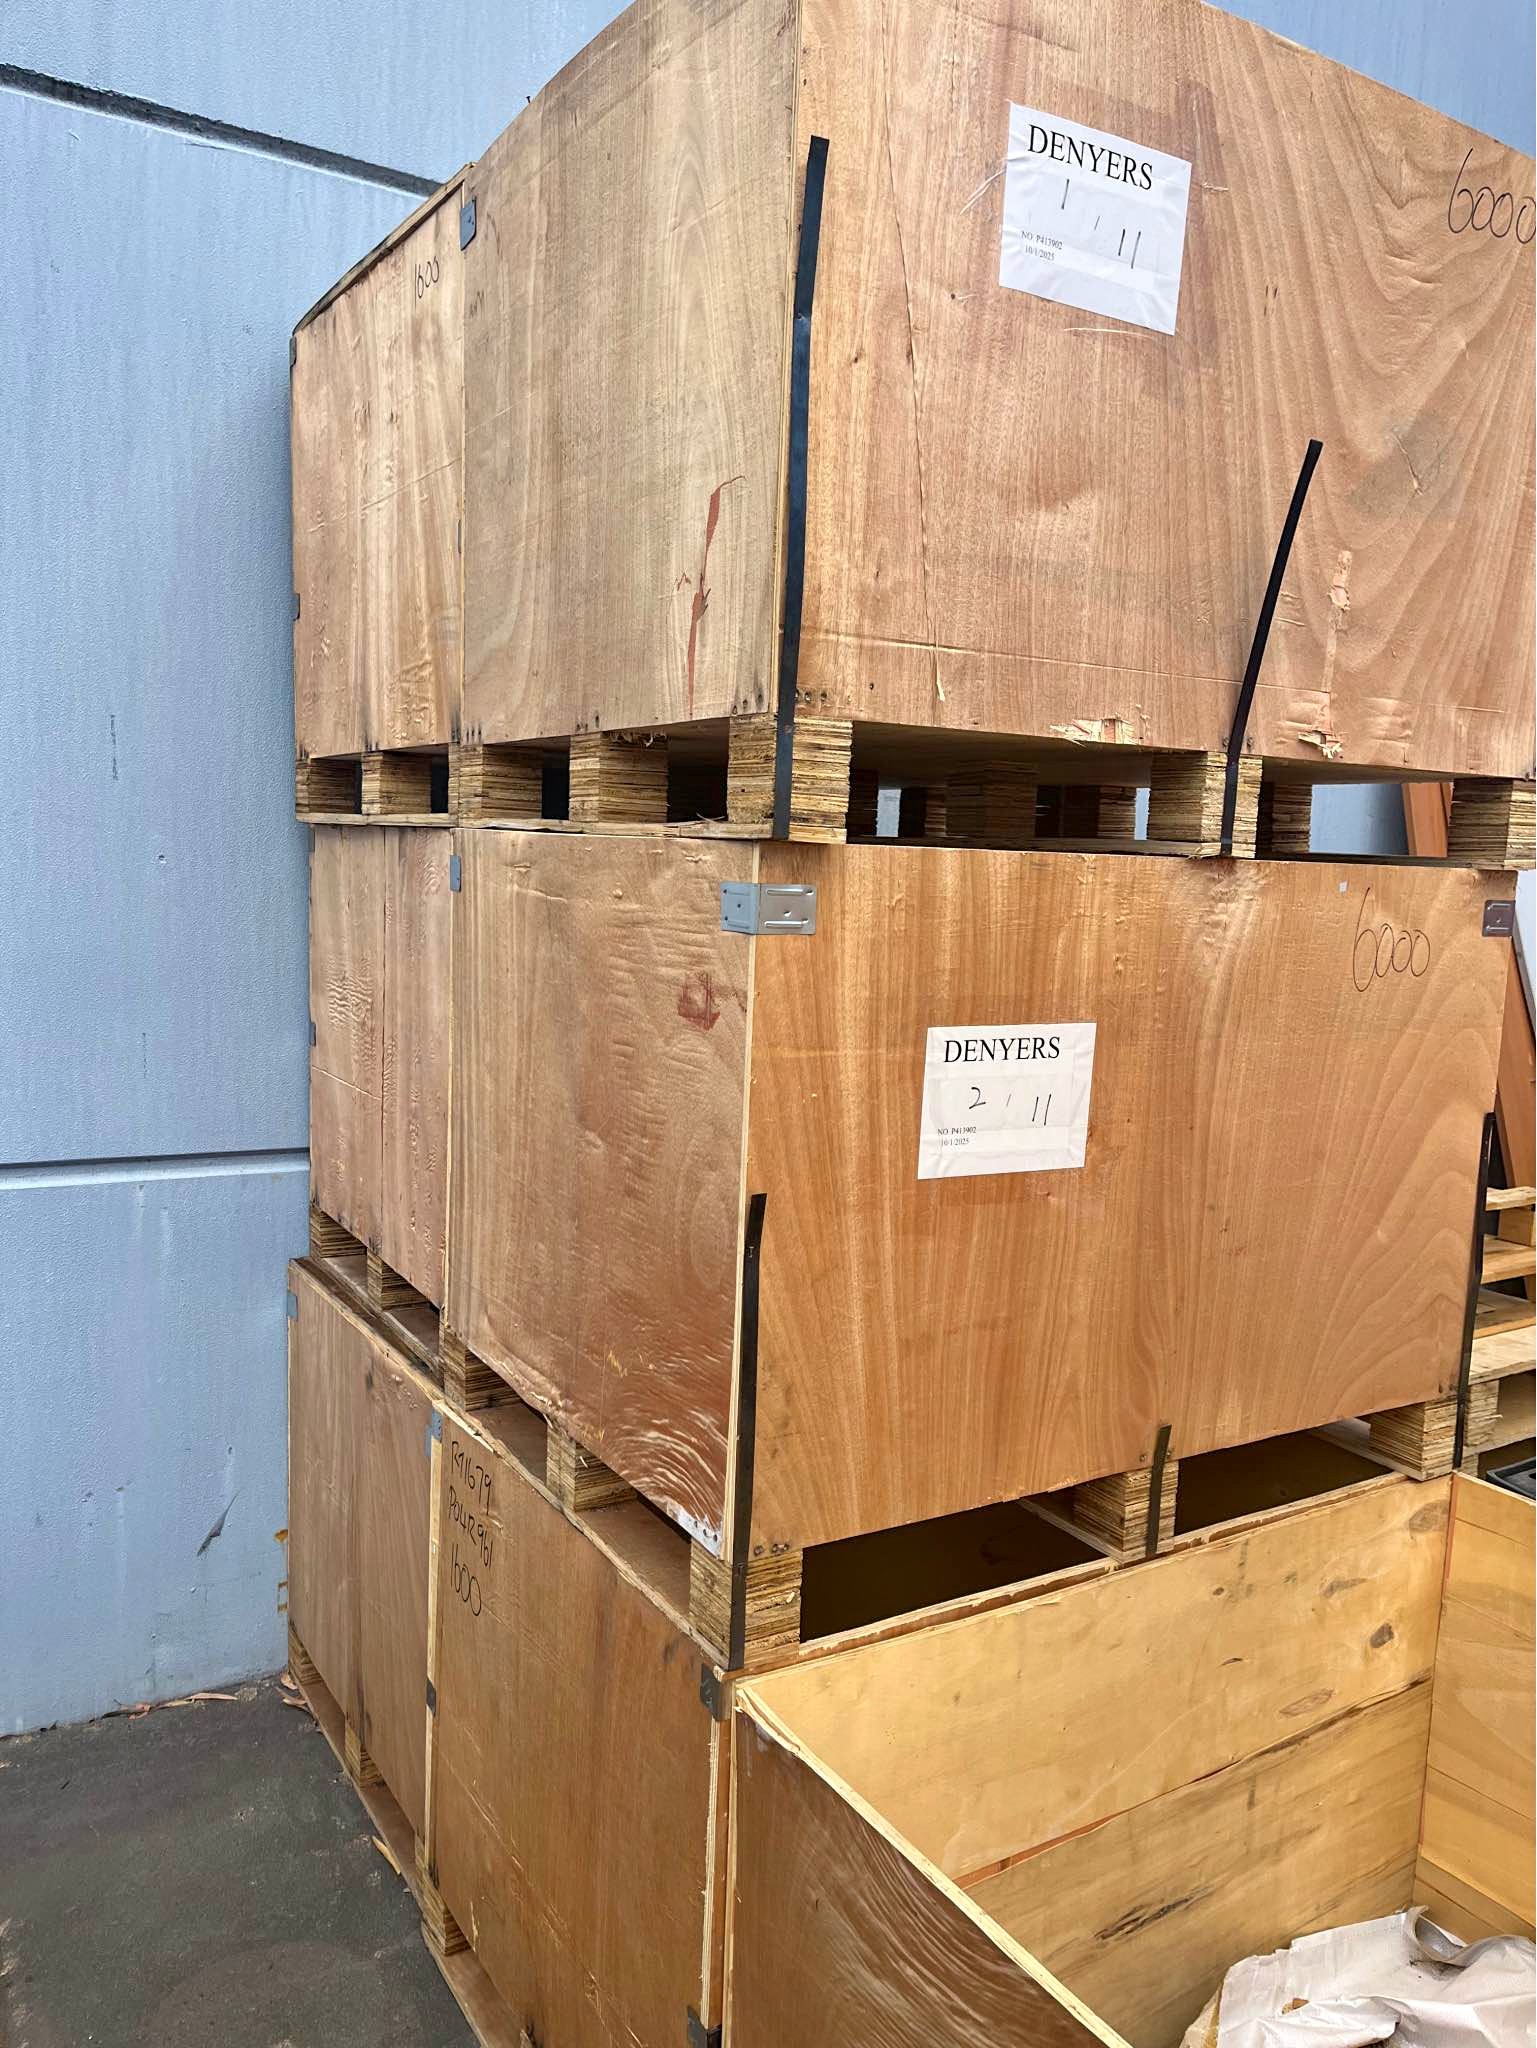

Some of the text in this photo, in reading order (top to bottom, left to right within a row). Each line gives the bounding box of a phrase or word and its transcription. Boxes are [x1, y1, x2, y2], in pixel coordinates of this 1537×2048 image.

[1027, 124, 1153, 191] DENYERS
[1447, 147, 1537, 245] 6000
[1352, 886, 1431, 993] 6000
[943, 1036, 1061, 1063] DENYERS
[968, 1086, 986, 1110] 2
[450, 1543, 483, 1617] 1600
